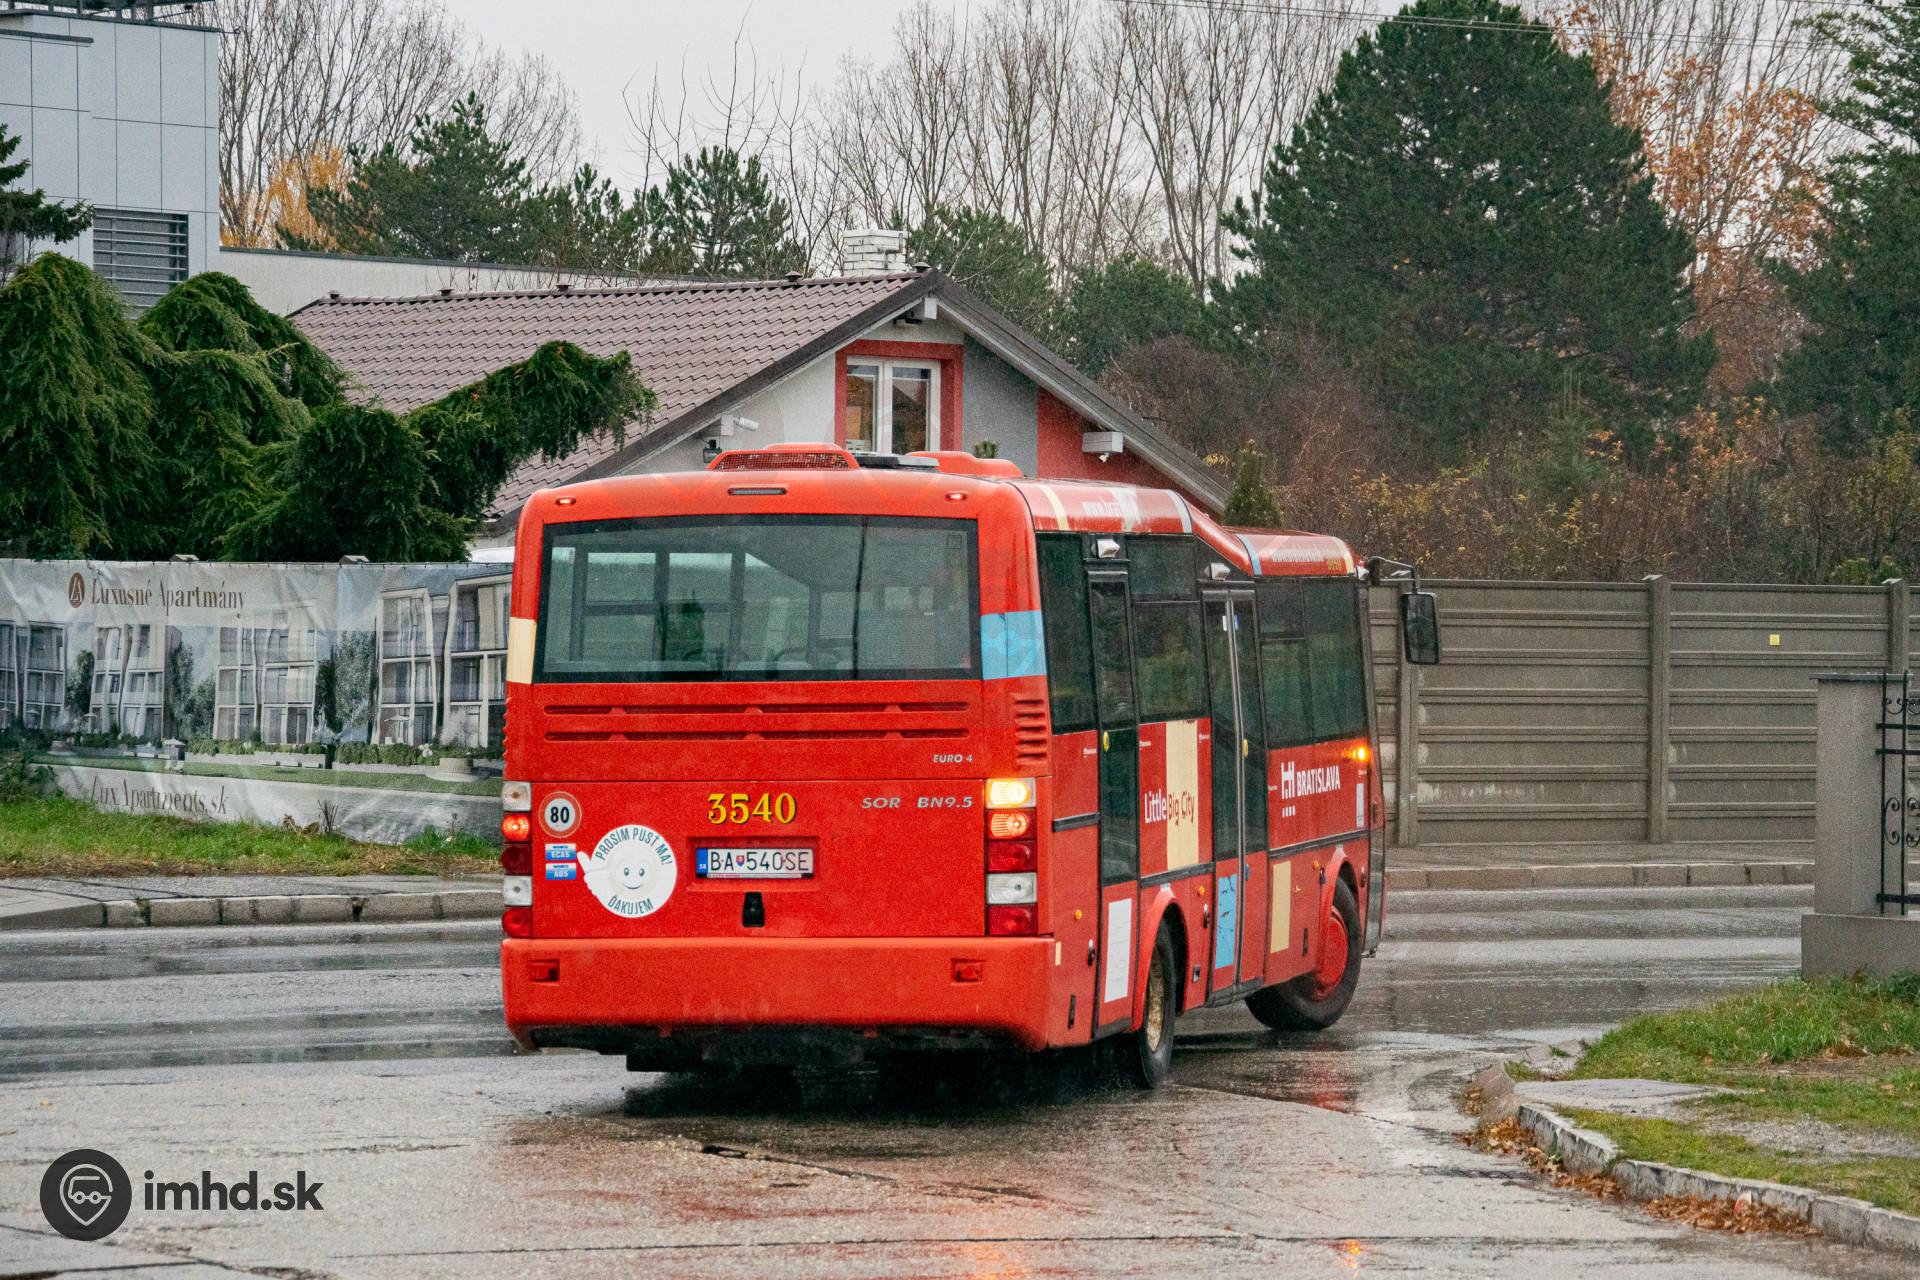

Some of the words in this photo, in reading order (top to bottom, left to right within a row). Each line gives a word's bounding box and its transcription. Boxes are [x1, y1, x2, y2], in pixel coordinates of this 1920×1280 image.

[91, 578, 152, 607] Luxusné
[933, 754, 963, 763] EURO
[966, 754, 973, 763] 4
[1296, 765, 1341, 797] BRATISLAVA
[550, 806, 570, 824] 80
[707, 792, 798, 825] 3540
[862, 797, 902, 809] SOR
[917, 796, 973, 809] BN9.5
[1144, 788, 1167, 824] Little
[1168, 792, 1180, 827] Big
[1181, 791, 1195, 825] City
[655, 843, 673, 866] MA!
